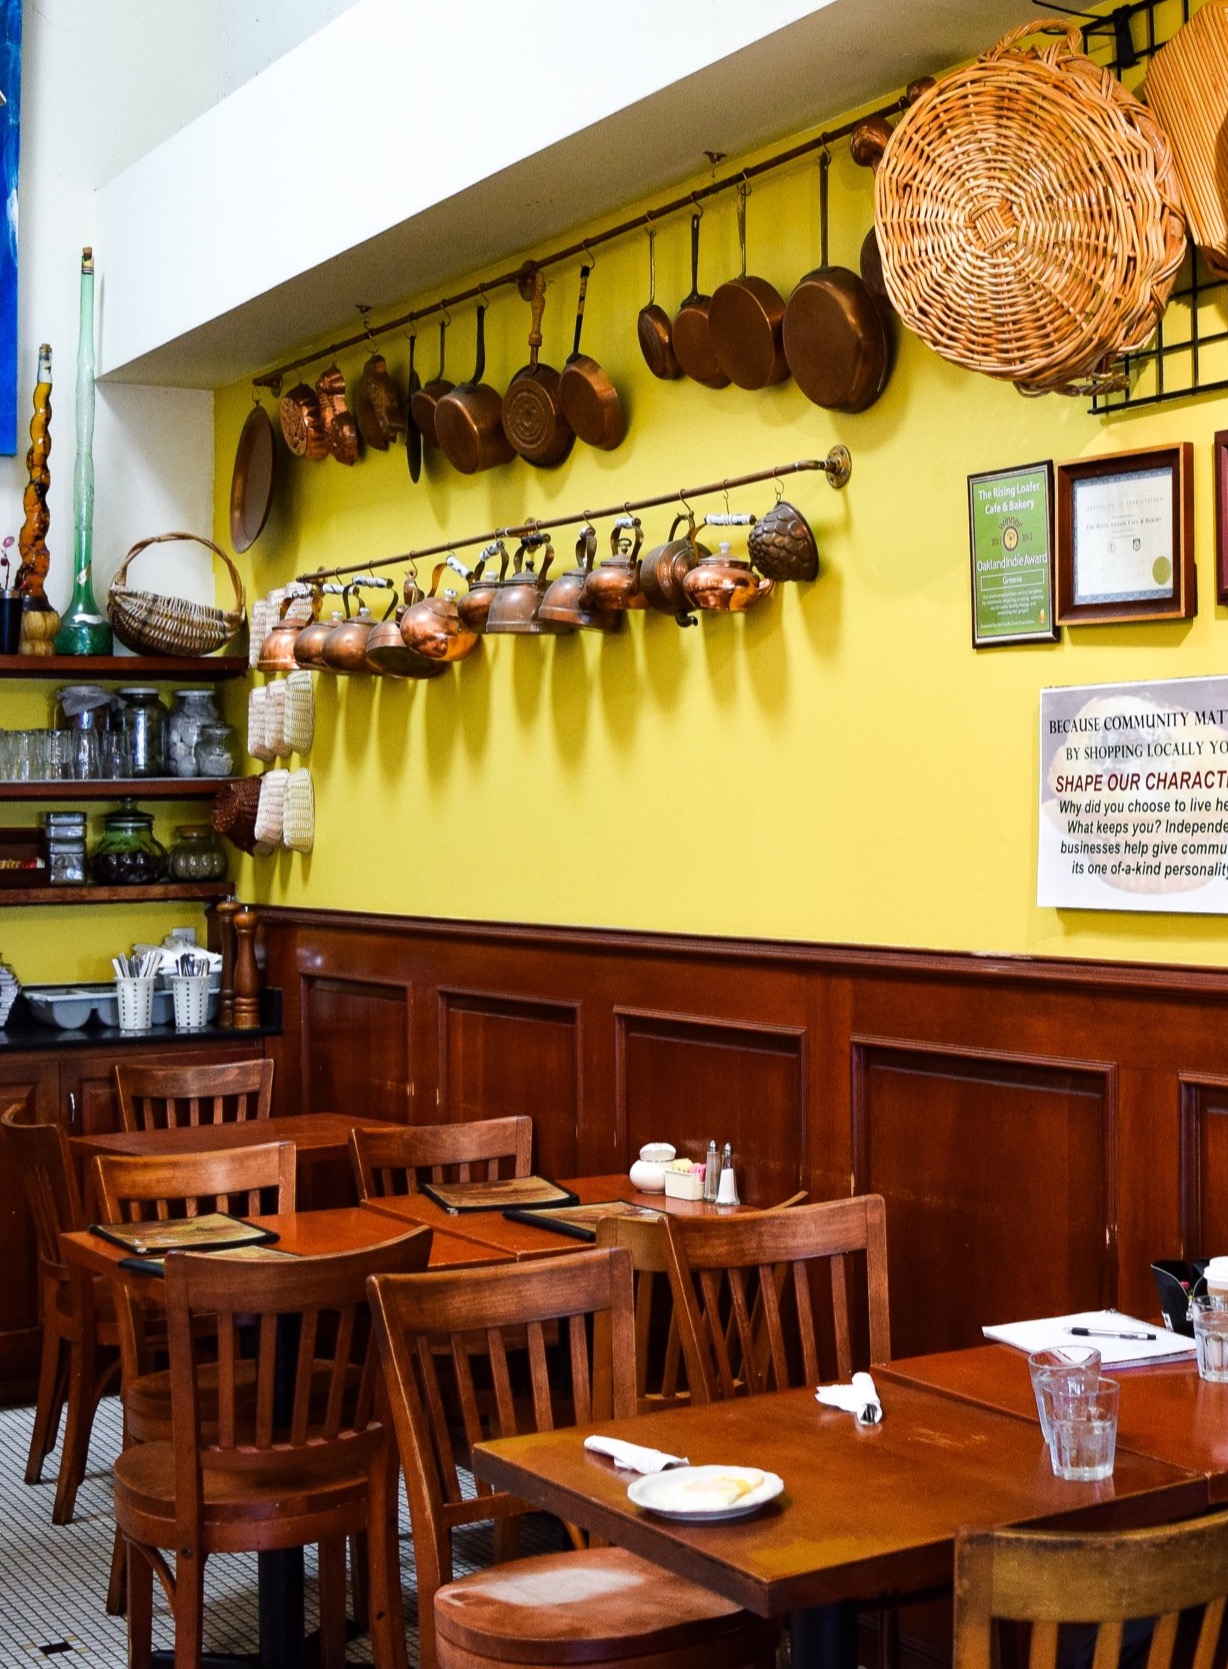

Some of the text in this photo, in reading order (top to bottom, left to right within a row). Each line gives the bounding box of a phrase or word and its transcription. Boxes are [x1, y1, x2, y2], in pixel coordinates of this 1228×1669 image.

[978, 481, 1040, 500] The Rising Loafer
[985, 499, 1034, 514] Cafe & Bakery
[998, 516, 1022, 530] winner
[1049, 717, 1100, 734] BECAUSE
[1104, 712, 1189, 731] COMMUNITY
[1066, 748, 1080, 761] BY
[1084, 744, 1143, 760] SHOPPING
[1148, 742, 1204, 757] LOCALLY
[1056, 774, 1103, 793] SHAPE
[1108, 774, 1141, 791] OUR
[1059, 800, 1081, 816] Why
[1085, 800, 1101, 814] did
[1104, 802, 1124, 816] you
[1128, 800, 1170, 813] choose
[1174, 800, 1186, 812] to
[1191, 798, 1211, 811] live
[1068, 820, 1093, 834] What
[1097, 821, 1128, 836] keeps
[1132, 820, 1161, 836] you?
[1061, 841, 1120, 854] businesses
[1124, 841, 1148, 856] help
[1152, 842, 1177, 857] give
[1072, 861, 1084, 874] its
[1088, 864, 1107, 874] one
[1111, 861, 1160, 875] of-a-kind
